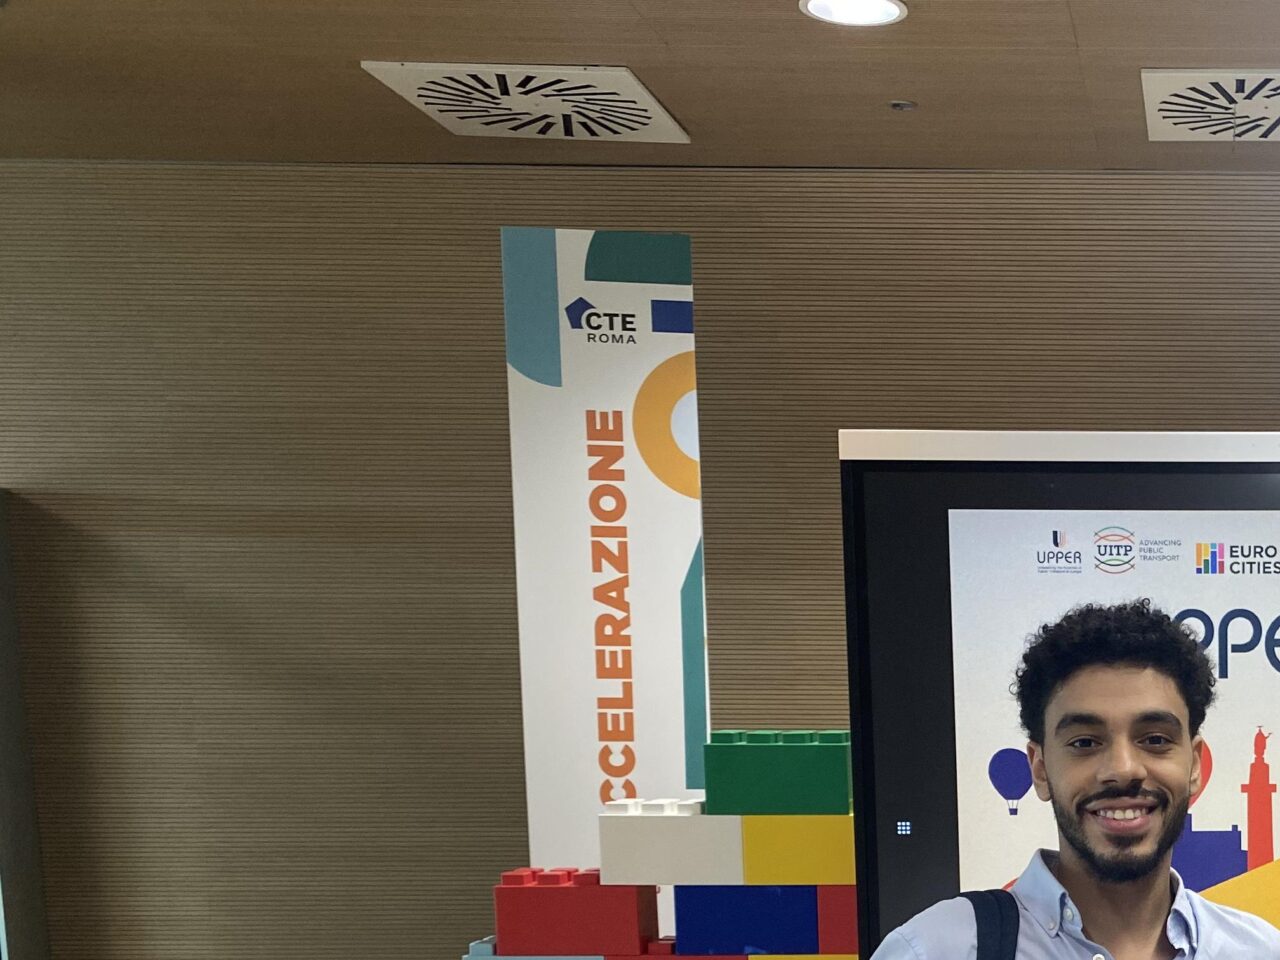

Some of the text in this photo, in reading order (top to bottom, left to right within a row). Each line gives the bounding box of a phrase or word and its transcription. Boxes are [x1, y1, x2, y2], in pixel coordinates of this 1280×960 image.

[585, 312, 637, 332] CTE
[587, 333, 637, 345] ROMA
[1139, 539, 1182, 547] ADVANCING
[1097, 544, 1133, 557] UITP
[1230, 545, 1278, 559] EURO
[1037, 551, 1082, 564] UPPER
[1139, 554, 1180, 562] TRANSPORT
